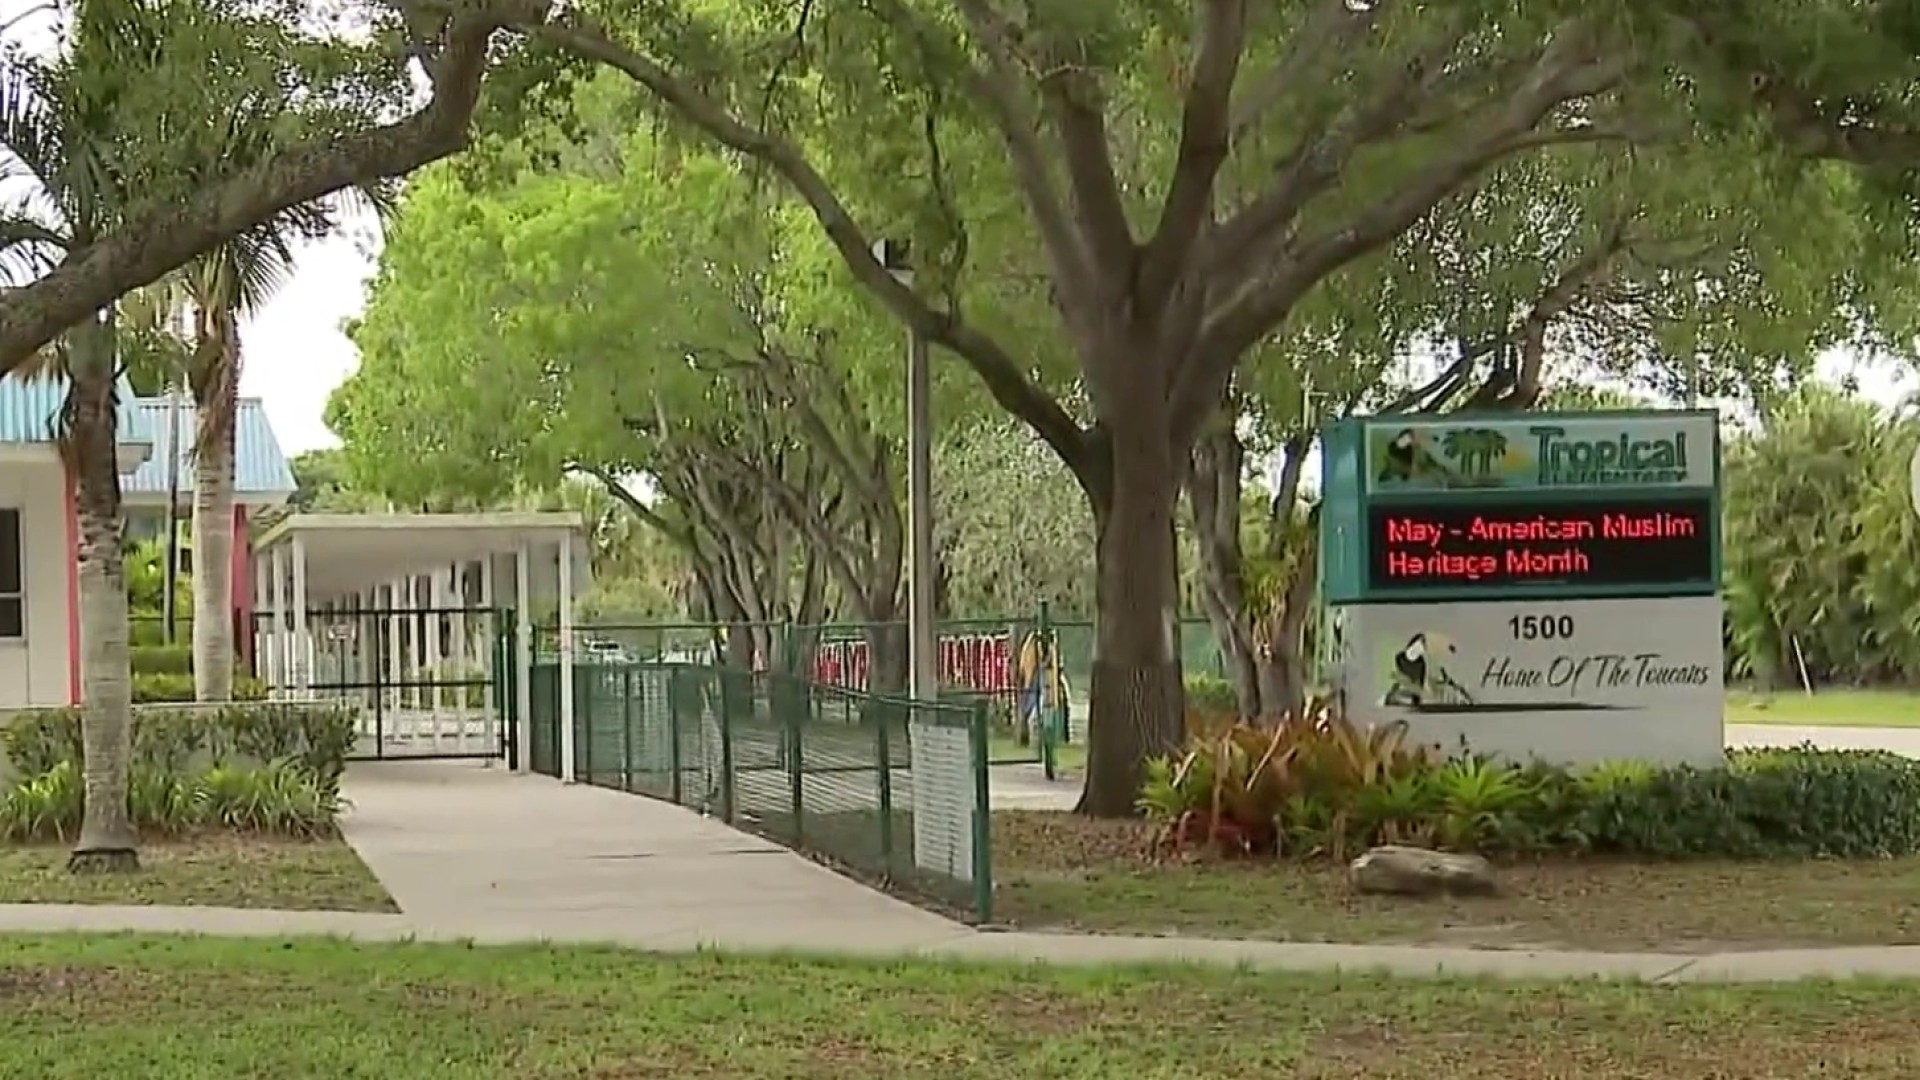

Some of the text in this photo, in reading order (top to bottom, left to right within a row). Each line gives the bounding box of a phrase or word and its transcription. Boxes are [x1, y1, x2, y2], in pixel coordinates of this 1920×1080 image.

[1529, 426, 1687, 470] Tropical
[1387, 519, 1442, 548] May
[1469, 516, 1594, 541] American
[1603, 514, 1695, 538] Muslim
[1389, 549, 1588, 579] Heritage Month
[1508, 615, 1575, 640] 1500
[1480, 653, 1709, 697] Home Of The Toucans
